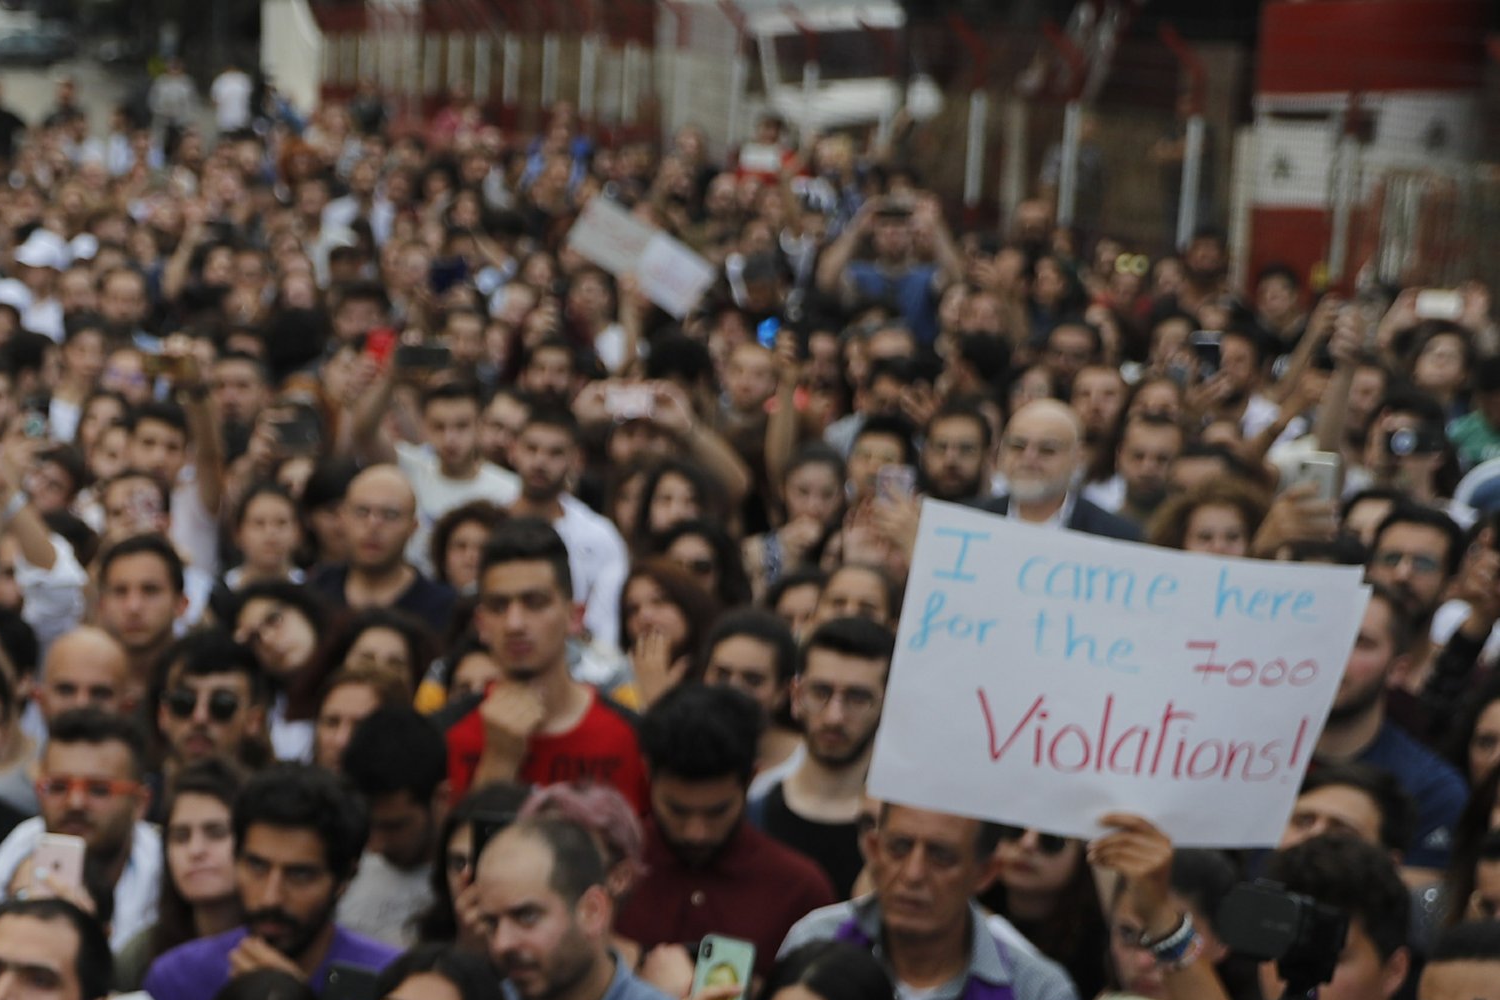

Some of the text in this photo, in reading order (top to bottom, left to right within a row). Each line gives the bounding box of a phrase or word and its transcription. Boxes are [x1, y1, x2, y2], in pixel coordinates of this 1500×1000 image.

[934, 527, 1317, 622] I came here
[909, 591, 1319, 686] for the 7000
[977, 688, 1311, 784] Violations!
